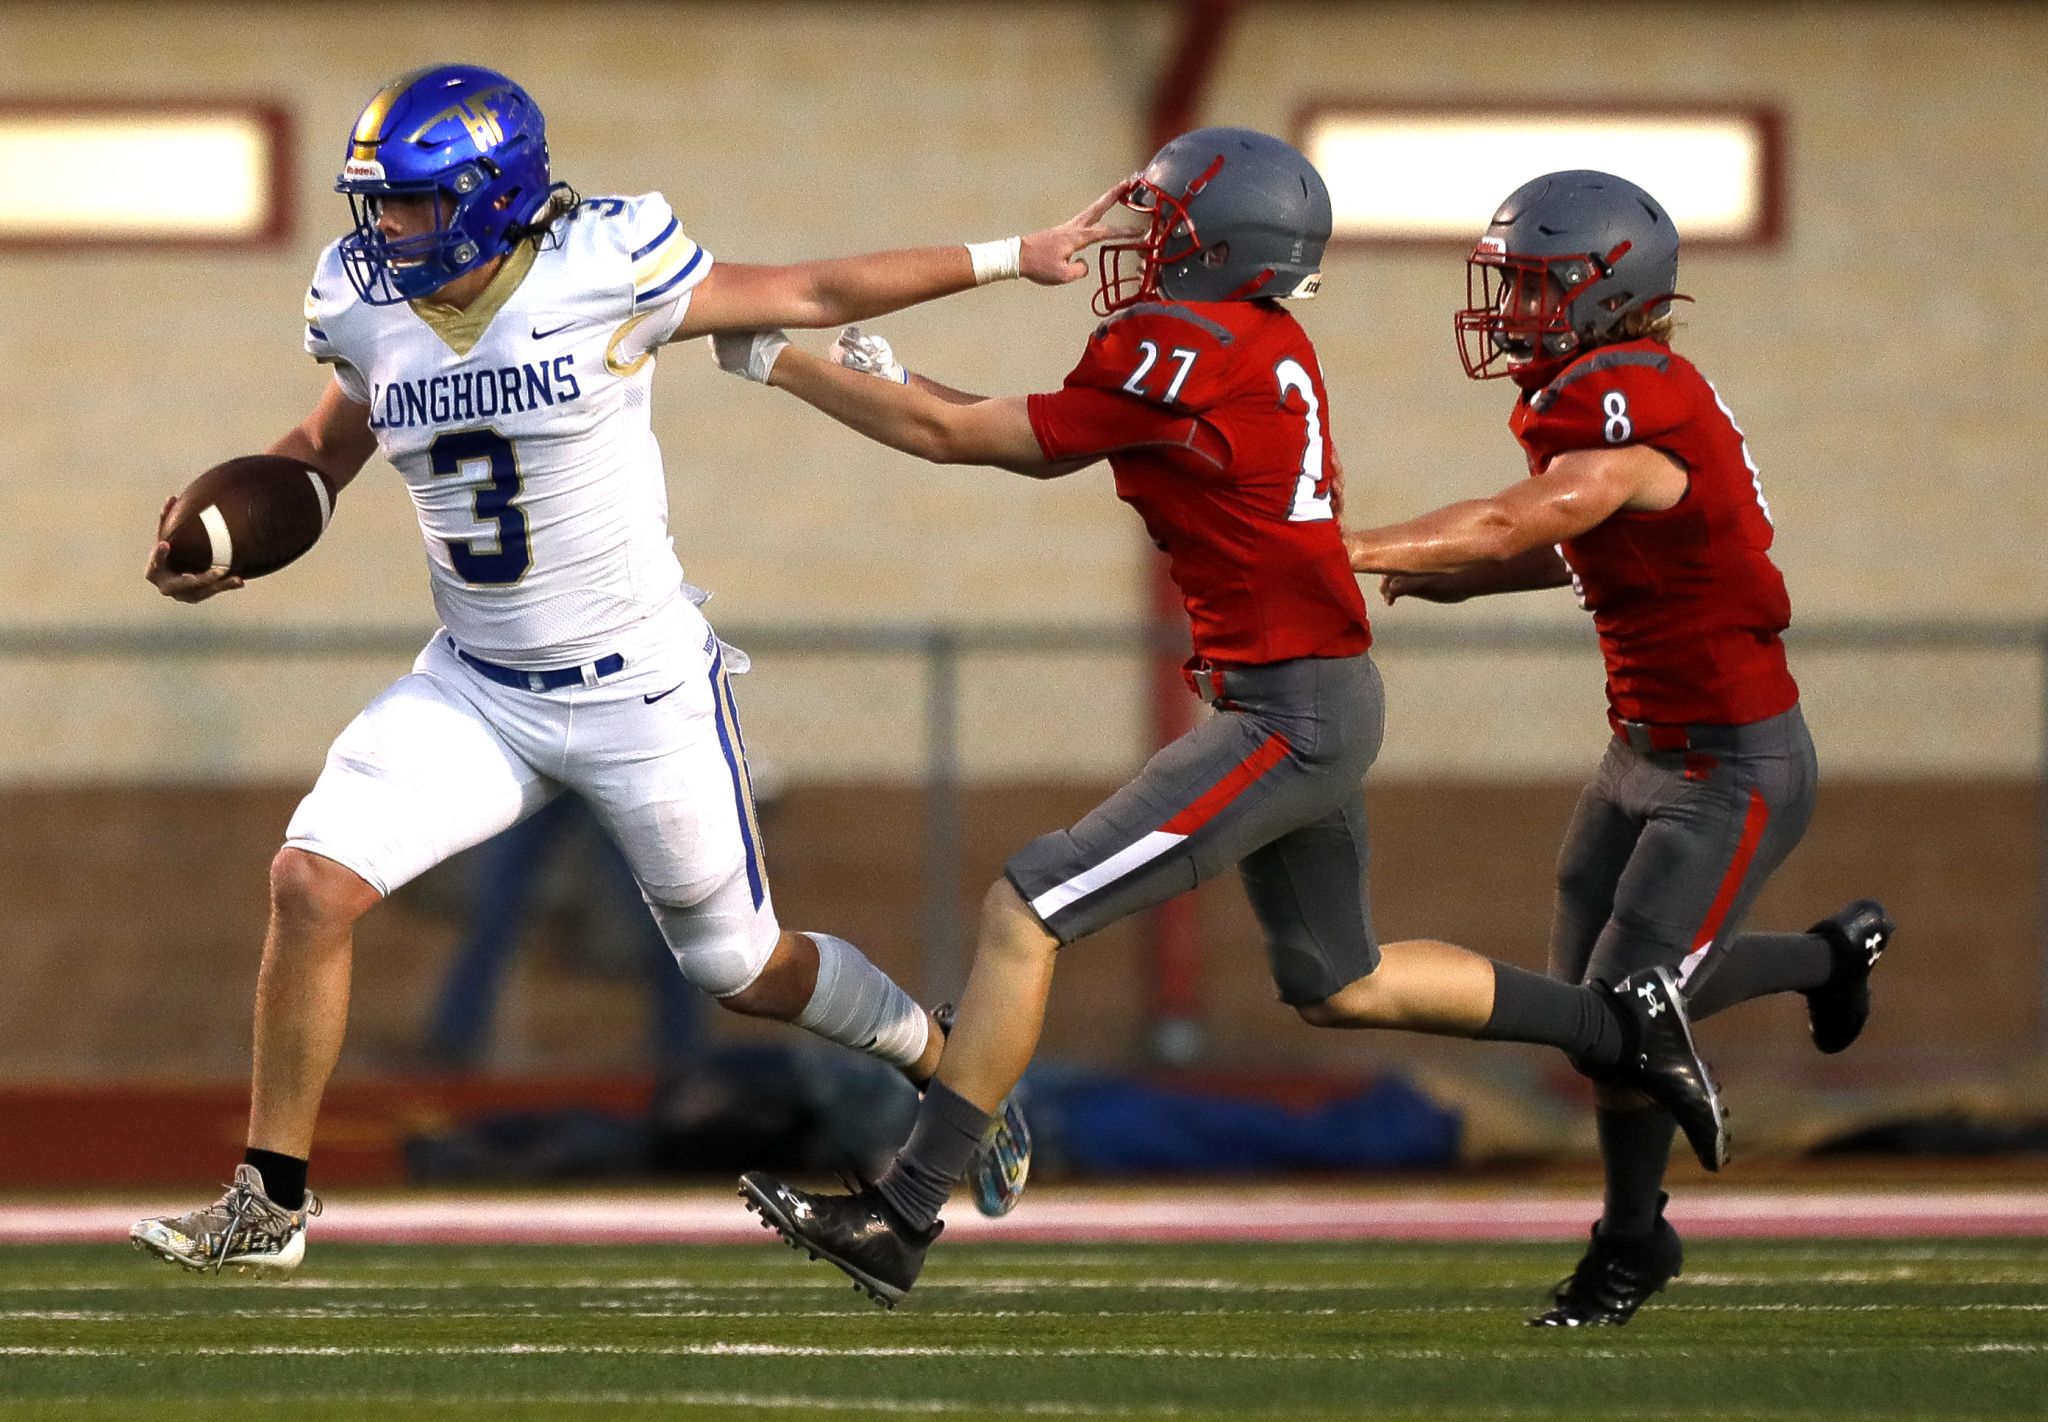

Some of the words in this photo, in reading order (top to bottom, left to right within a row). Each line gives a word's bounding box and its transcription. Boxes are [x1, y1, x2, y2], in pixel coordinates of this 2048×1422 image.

[369, 354, 581, 429] LONGHORNS
[1122, 339, 1200, 404] 27
[1274, 357, 1333, 522] 2
[1602, 389, 1632, 443] 8
[428, 425, 535, 587] 3
